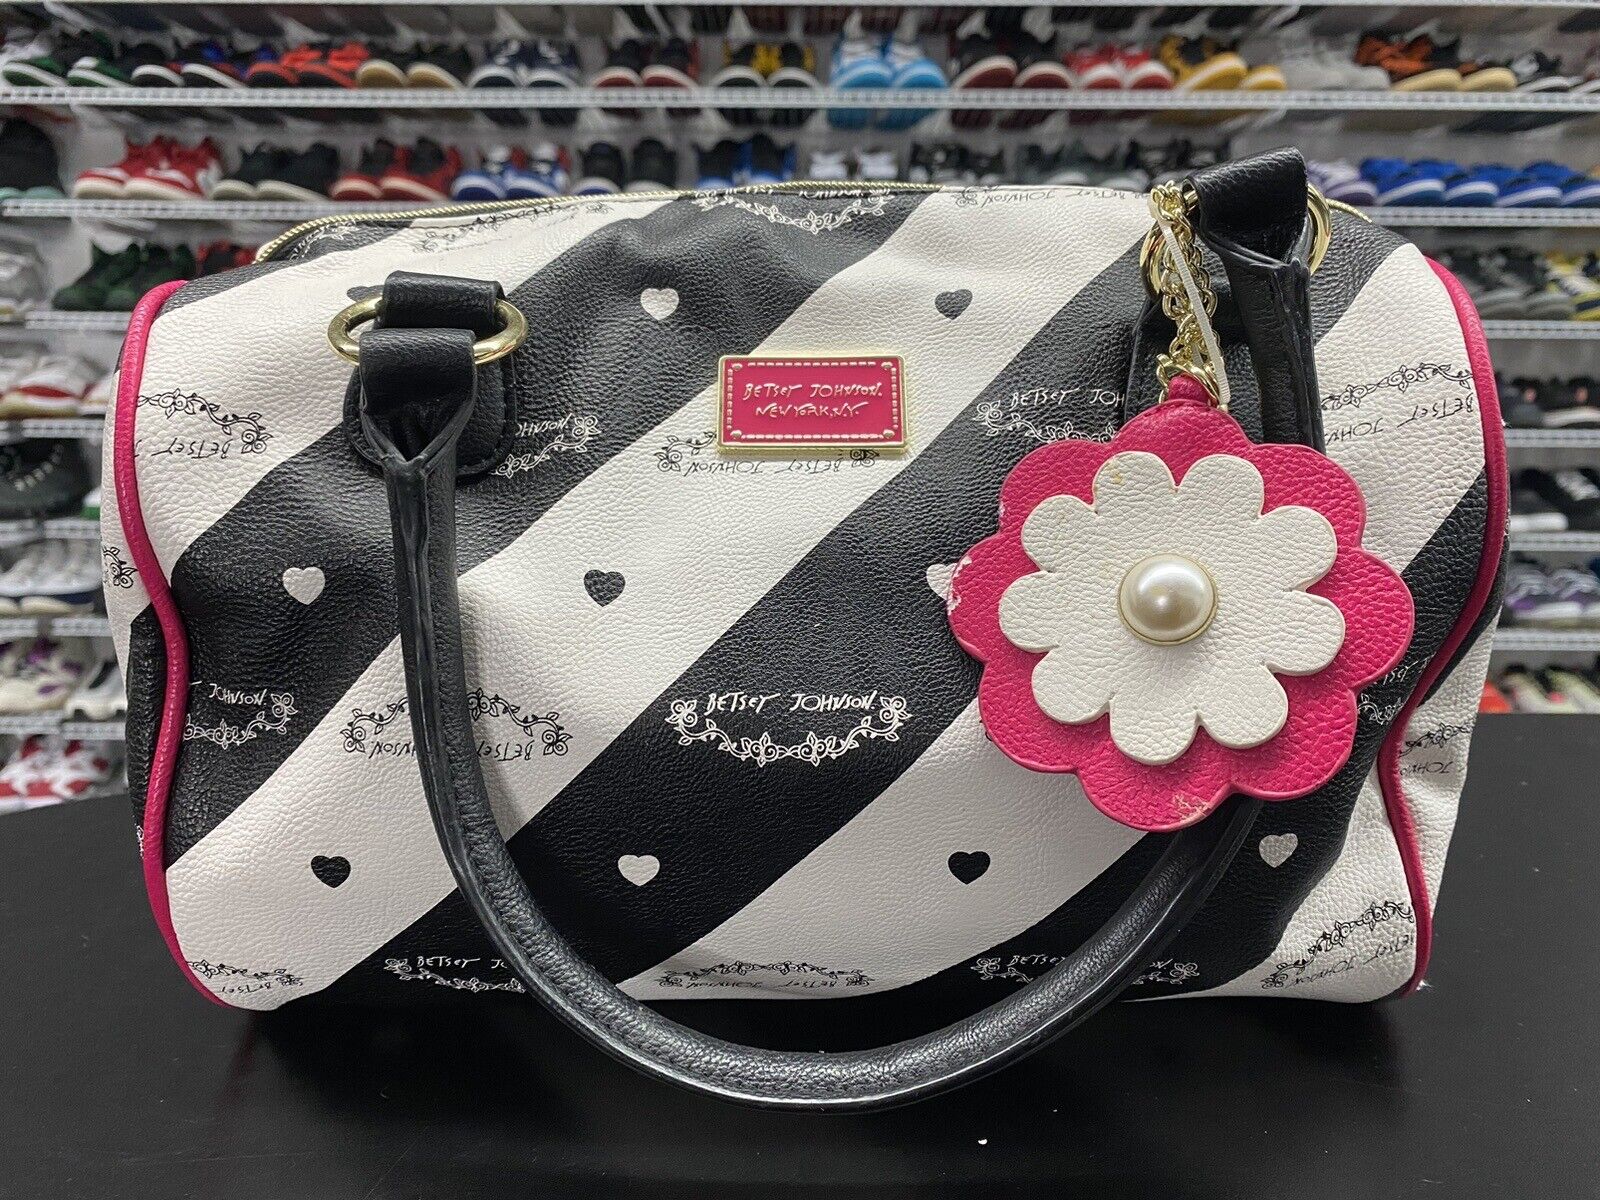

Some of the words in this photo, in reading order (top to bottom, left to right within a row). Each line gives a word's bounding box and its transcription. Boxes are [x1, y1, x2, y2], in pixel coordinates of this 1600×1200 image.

[743, 383, 803, 401] BETSEY
[151, 437, 232, 459] BETSEY
[774, 458, 842, 475] BETSEY
[703, 691, 782, 716] BETSEY
[417, 955, 481, 969] BETSEY
